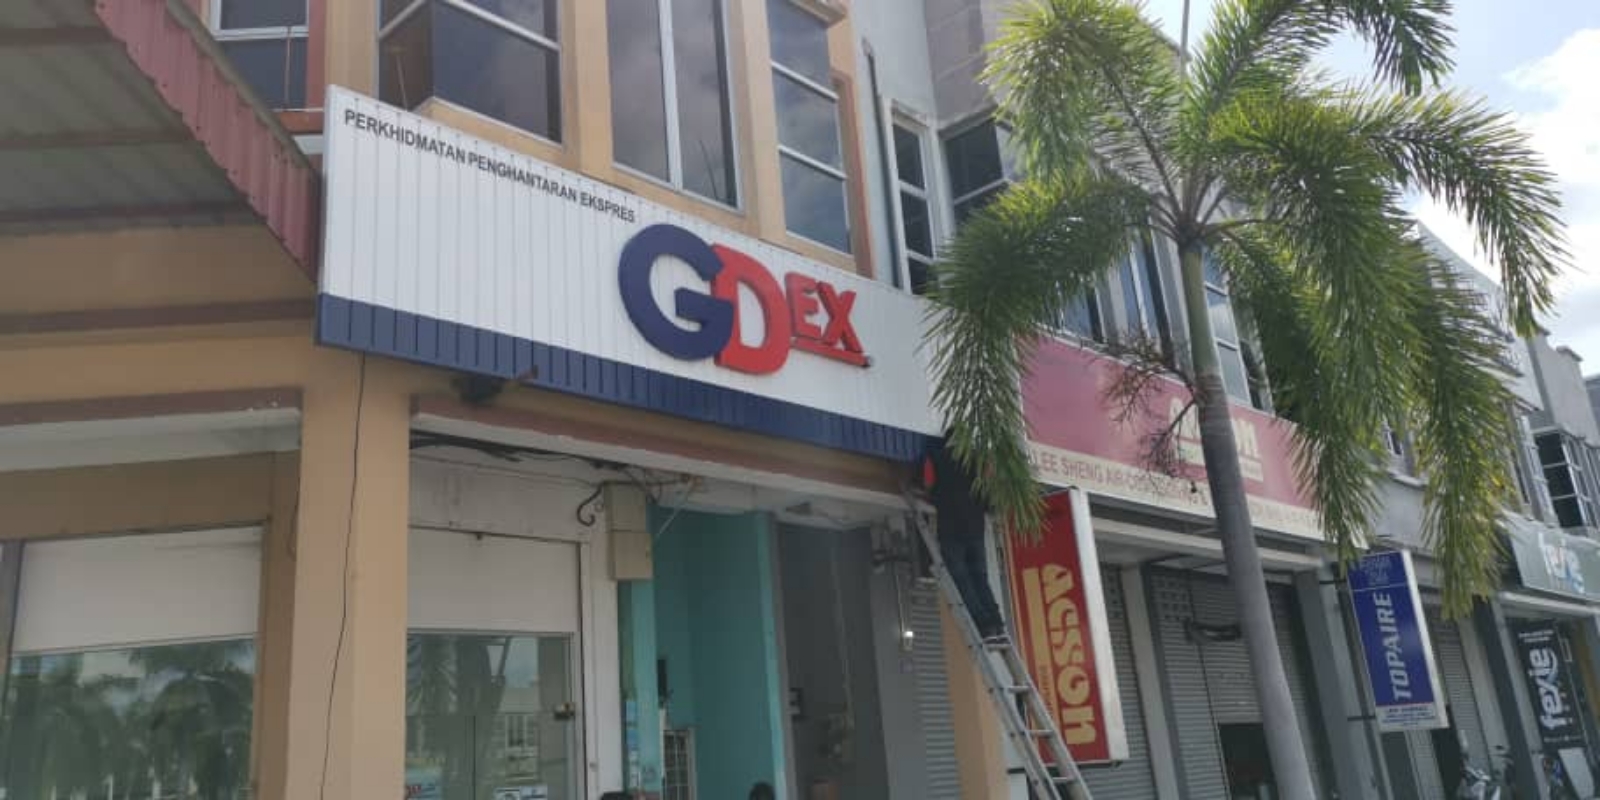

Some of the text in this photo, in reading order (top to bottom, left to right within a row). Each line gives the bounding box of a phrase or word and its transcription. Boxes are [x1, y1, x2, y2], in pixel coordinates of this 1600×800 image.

[344, 108, 636, 223] PERKHIDMATAN PENGHANTARAN EKSPRES
[618, 223, 866, 375] GDEX
[1061, 457, 1106, 484] SHENG
[1373, 591, 1412, 701] TOPAIRE
